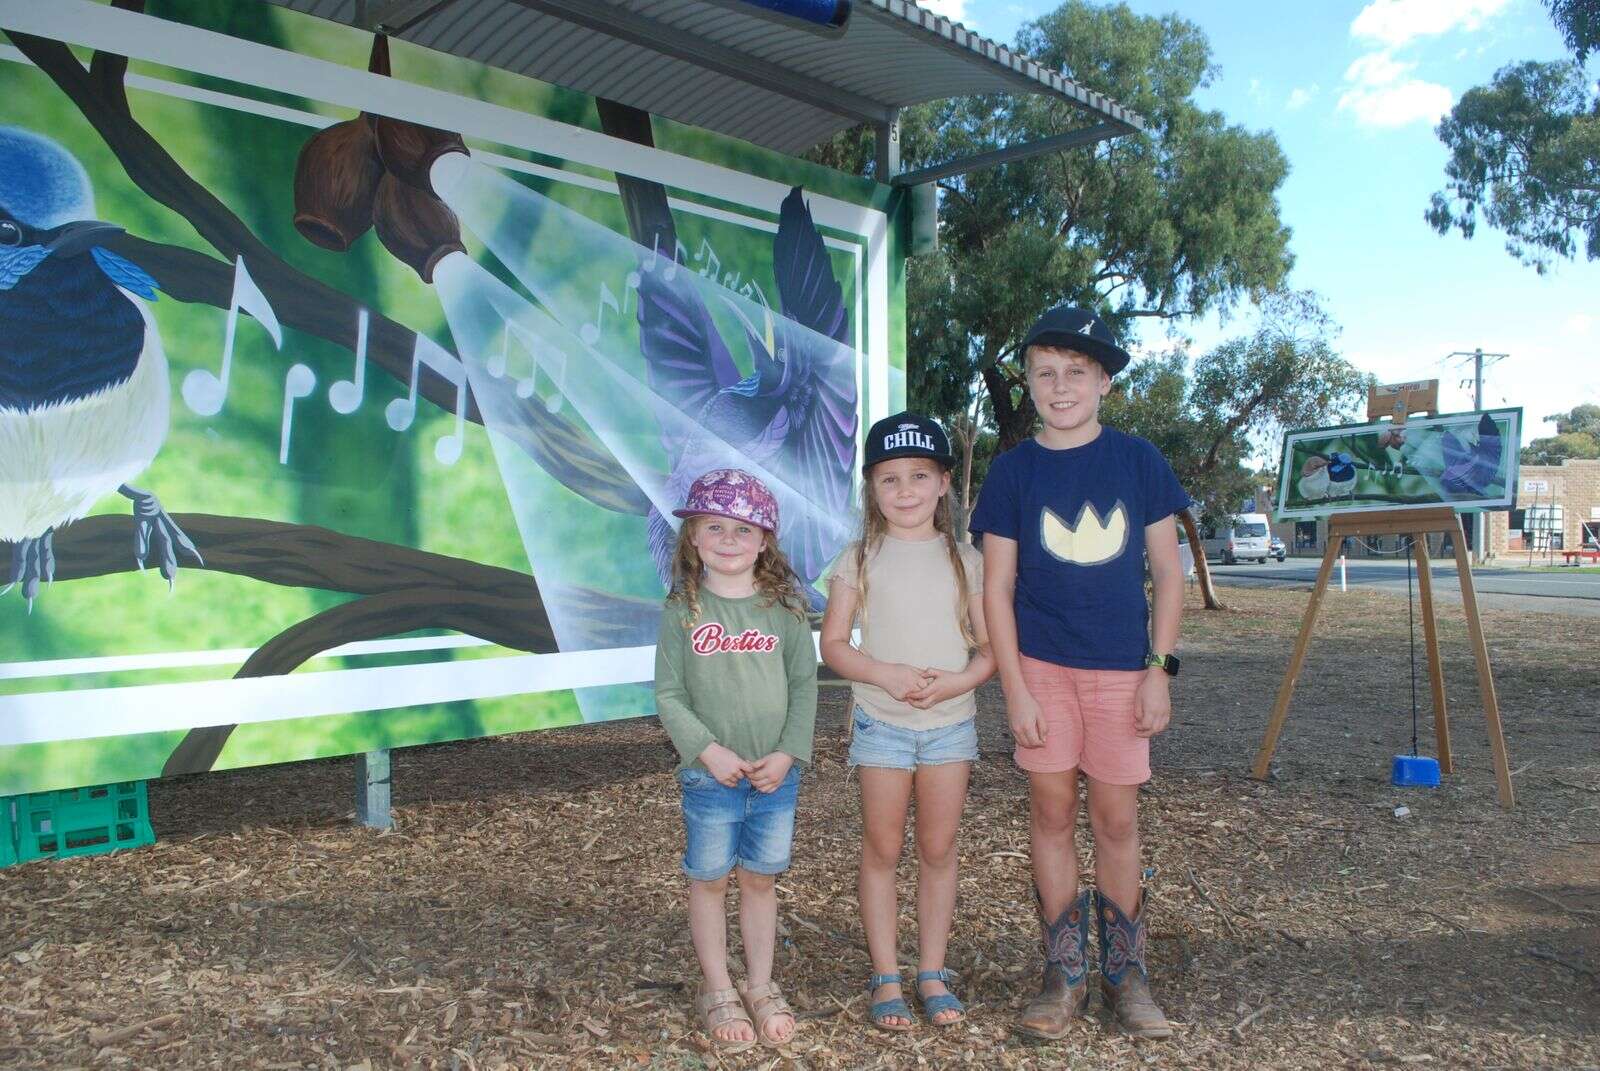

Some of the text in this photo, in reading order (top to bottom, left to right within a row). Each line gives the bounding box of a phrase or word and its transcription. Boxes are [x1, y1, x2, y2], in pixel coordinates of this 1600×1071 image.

[892, 124, 898, 142] 5
[884, 430, 935, 451] CHILL
[692, 623, 779, 656] Besties
